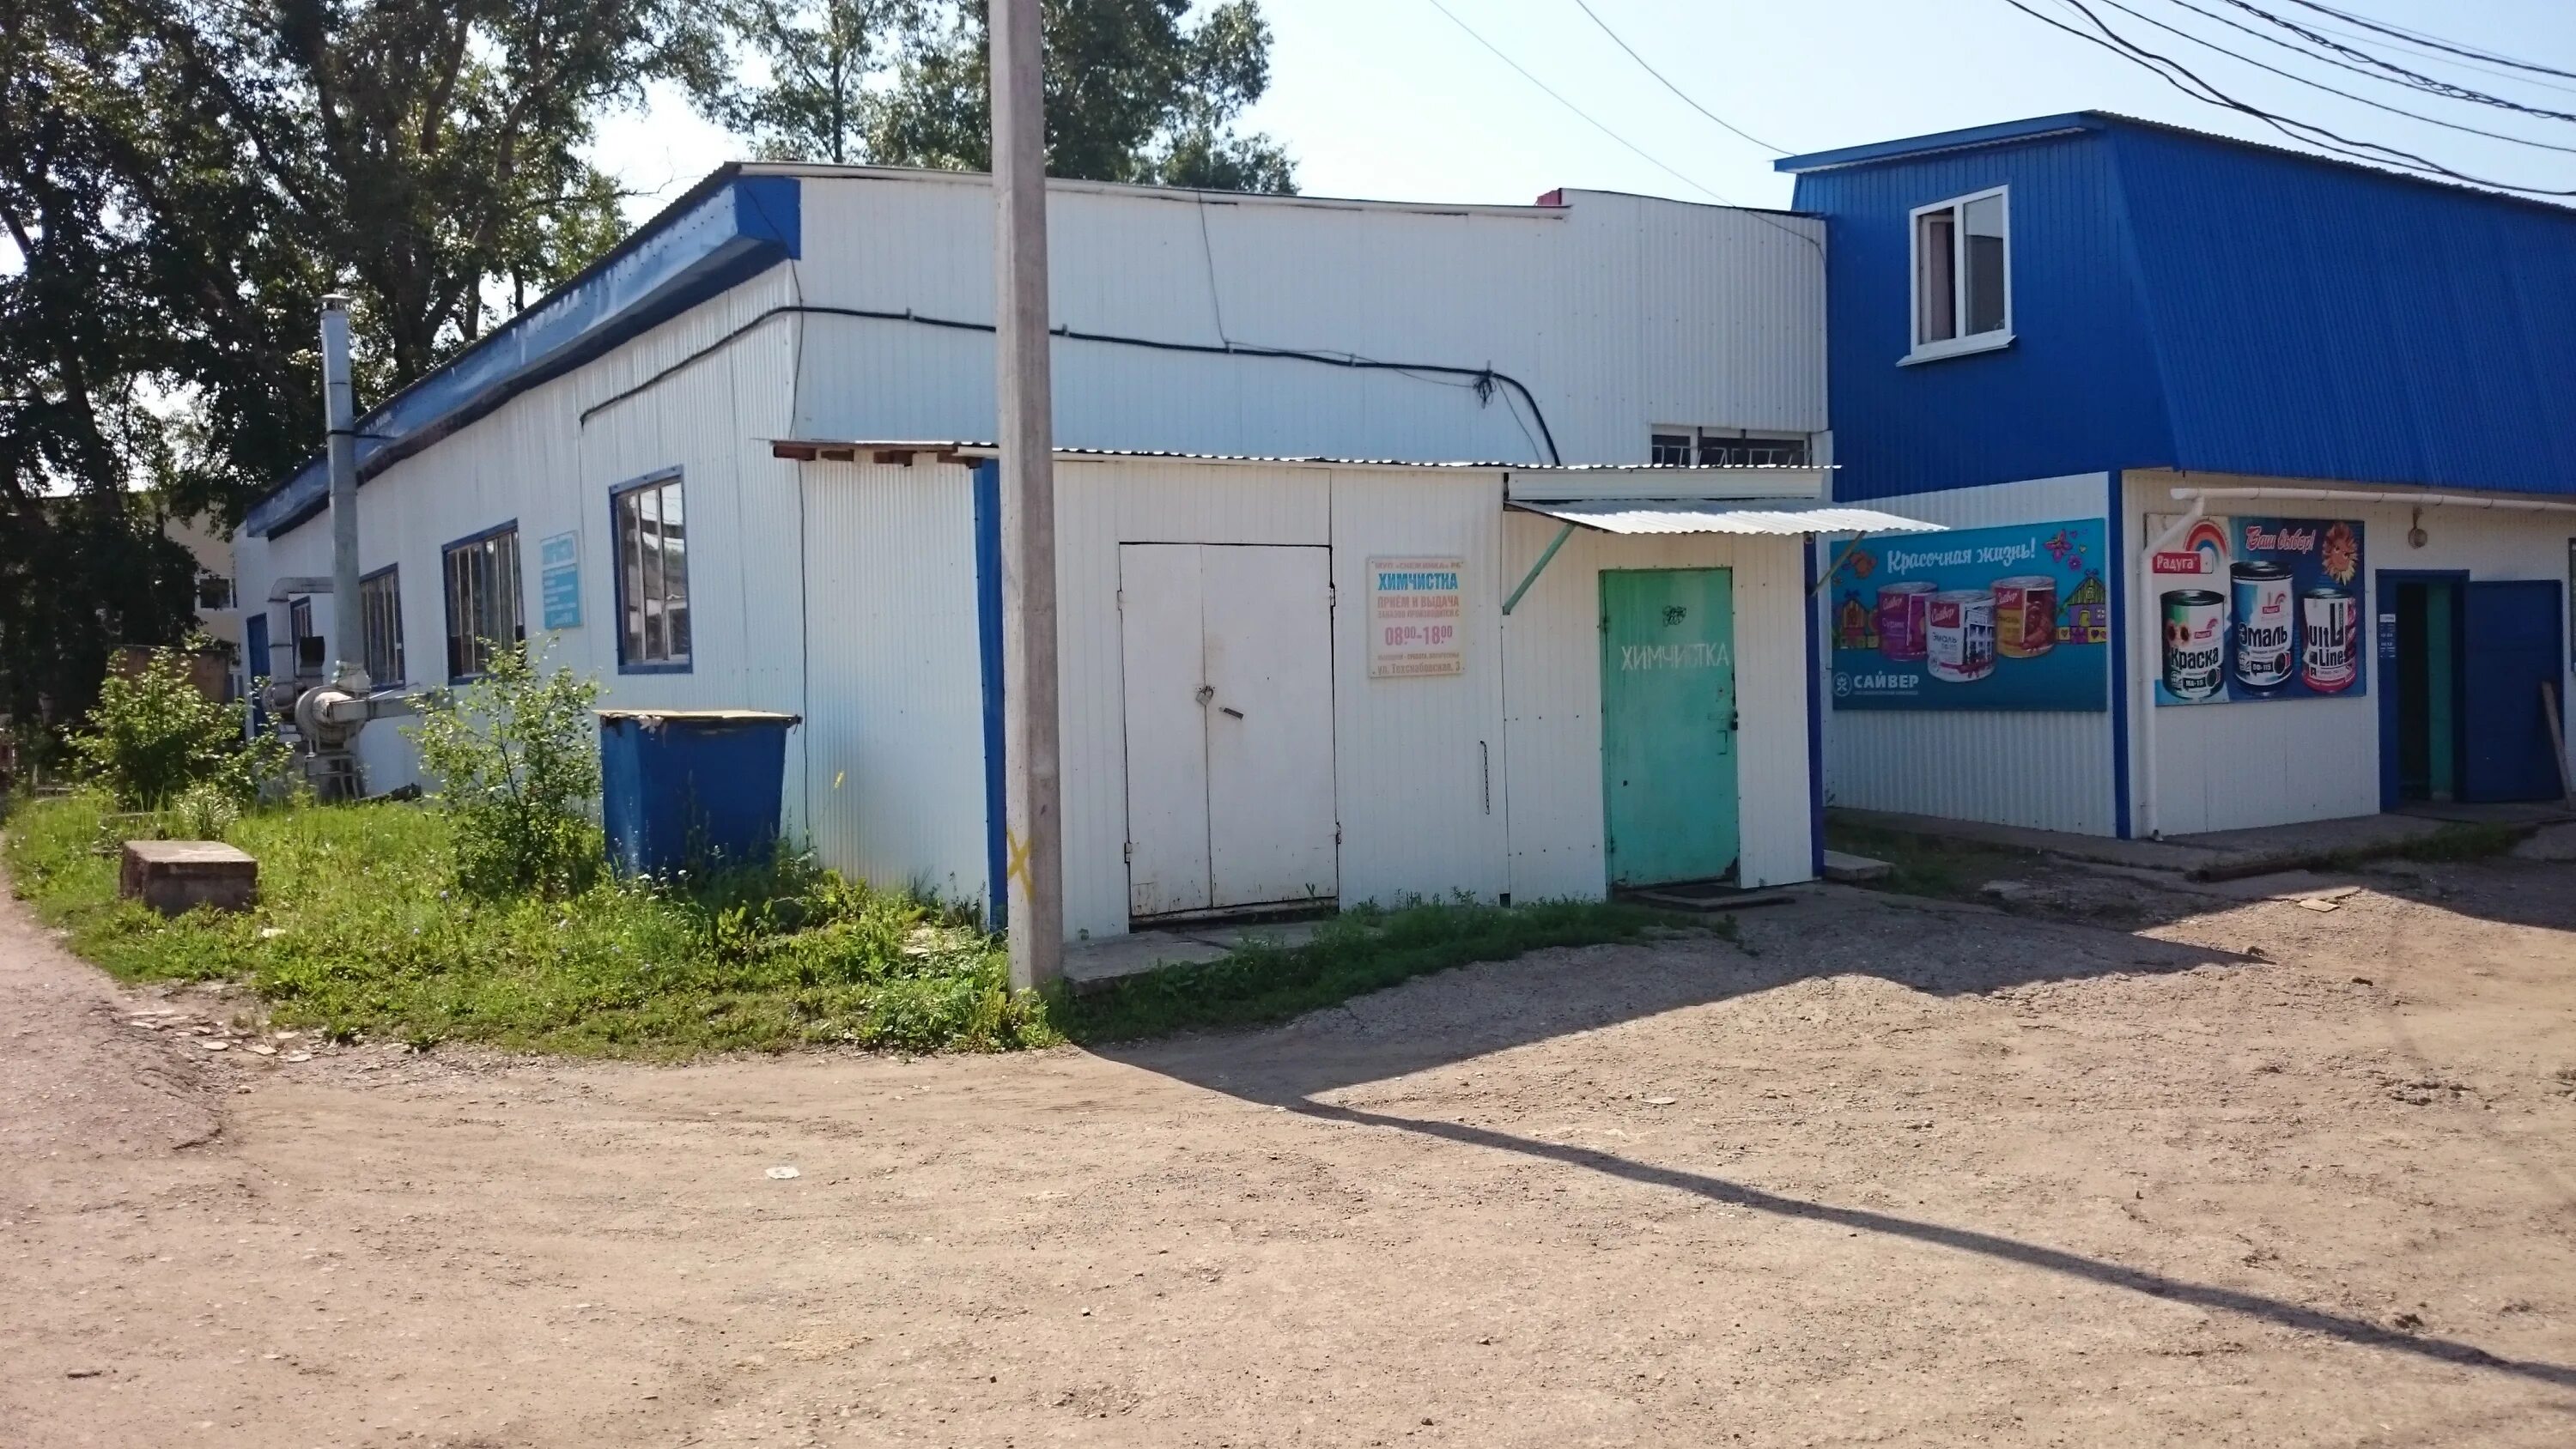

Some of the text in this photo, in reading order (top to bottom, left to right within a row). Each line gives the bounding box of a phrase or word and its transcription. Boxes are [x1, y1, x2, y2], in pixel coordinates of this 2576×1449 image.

[2246, 526, 2275, 553] Ваш
[1886, 537, 2036, 575] Красочная жизнь!
[2156, 553, 2194, 571] Радуга
[1377, 573, 1458, 591] ХИМЧИСТКА
[1413, 596, 1419, 609] И
[1421, 595, 1459, 609] ВЫДАЧА
[2239, 623, 2287, 647] Эмаль
[1620, 642, 1729, 670] ХИМЧИСТКА
[2169, 646, 2219, 670] Краска
[1854, 670, 1919, 688] САЙВЕР
